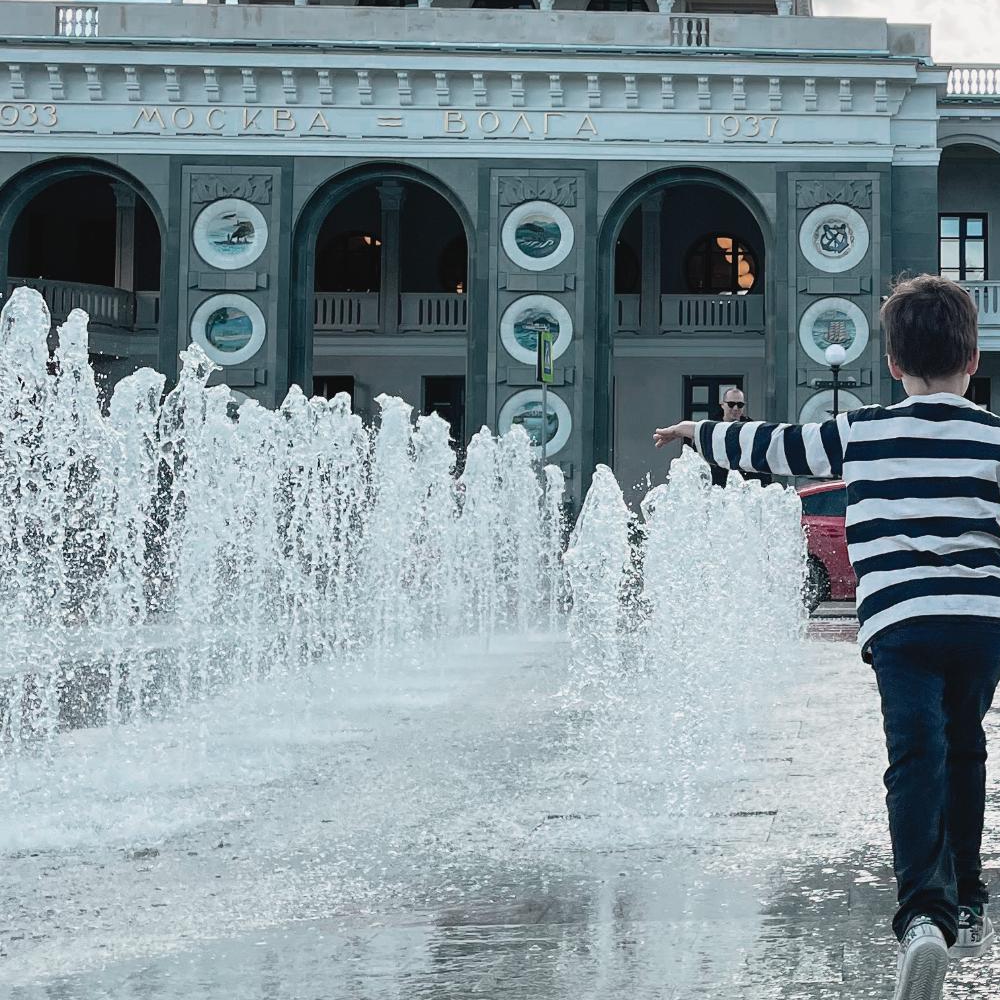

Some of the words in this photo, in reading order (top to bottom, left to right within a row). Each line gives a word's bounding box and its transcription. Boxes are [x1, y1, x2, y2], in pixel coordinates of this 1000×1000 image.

[132, 107, 331, 132] МОСКВА
[444, 112, 599, 136] ВОЛГА
[705, 115, 781, 137] 1937
